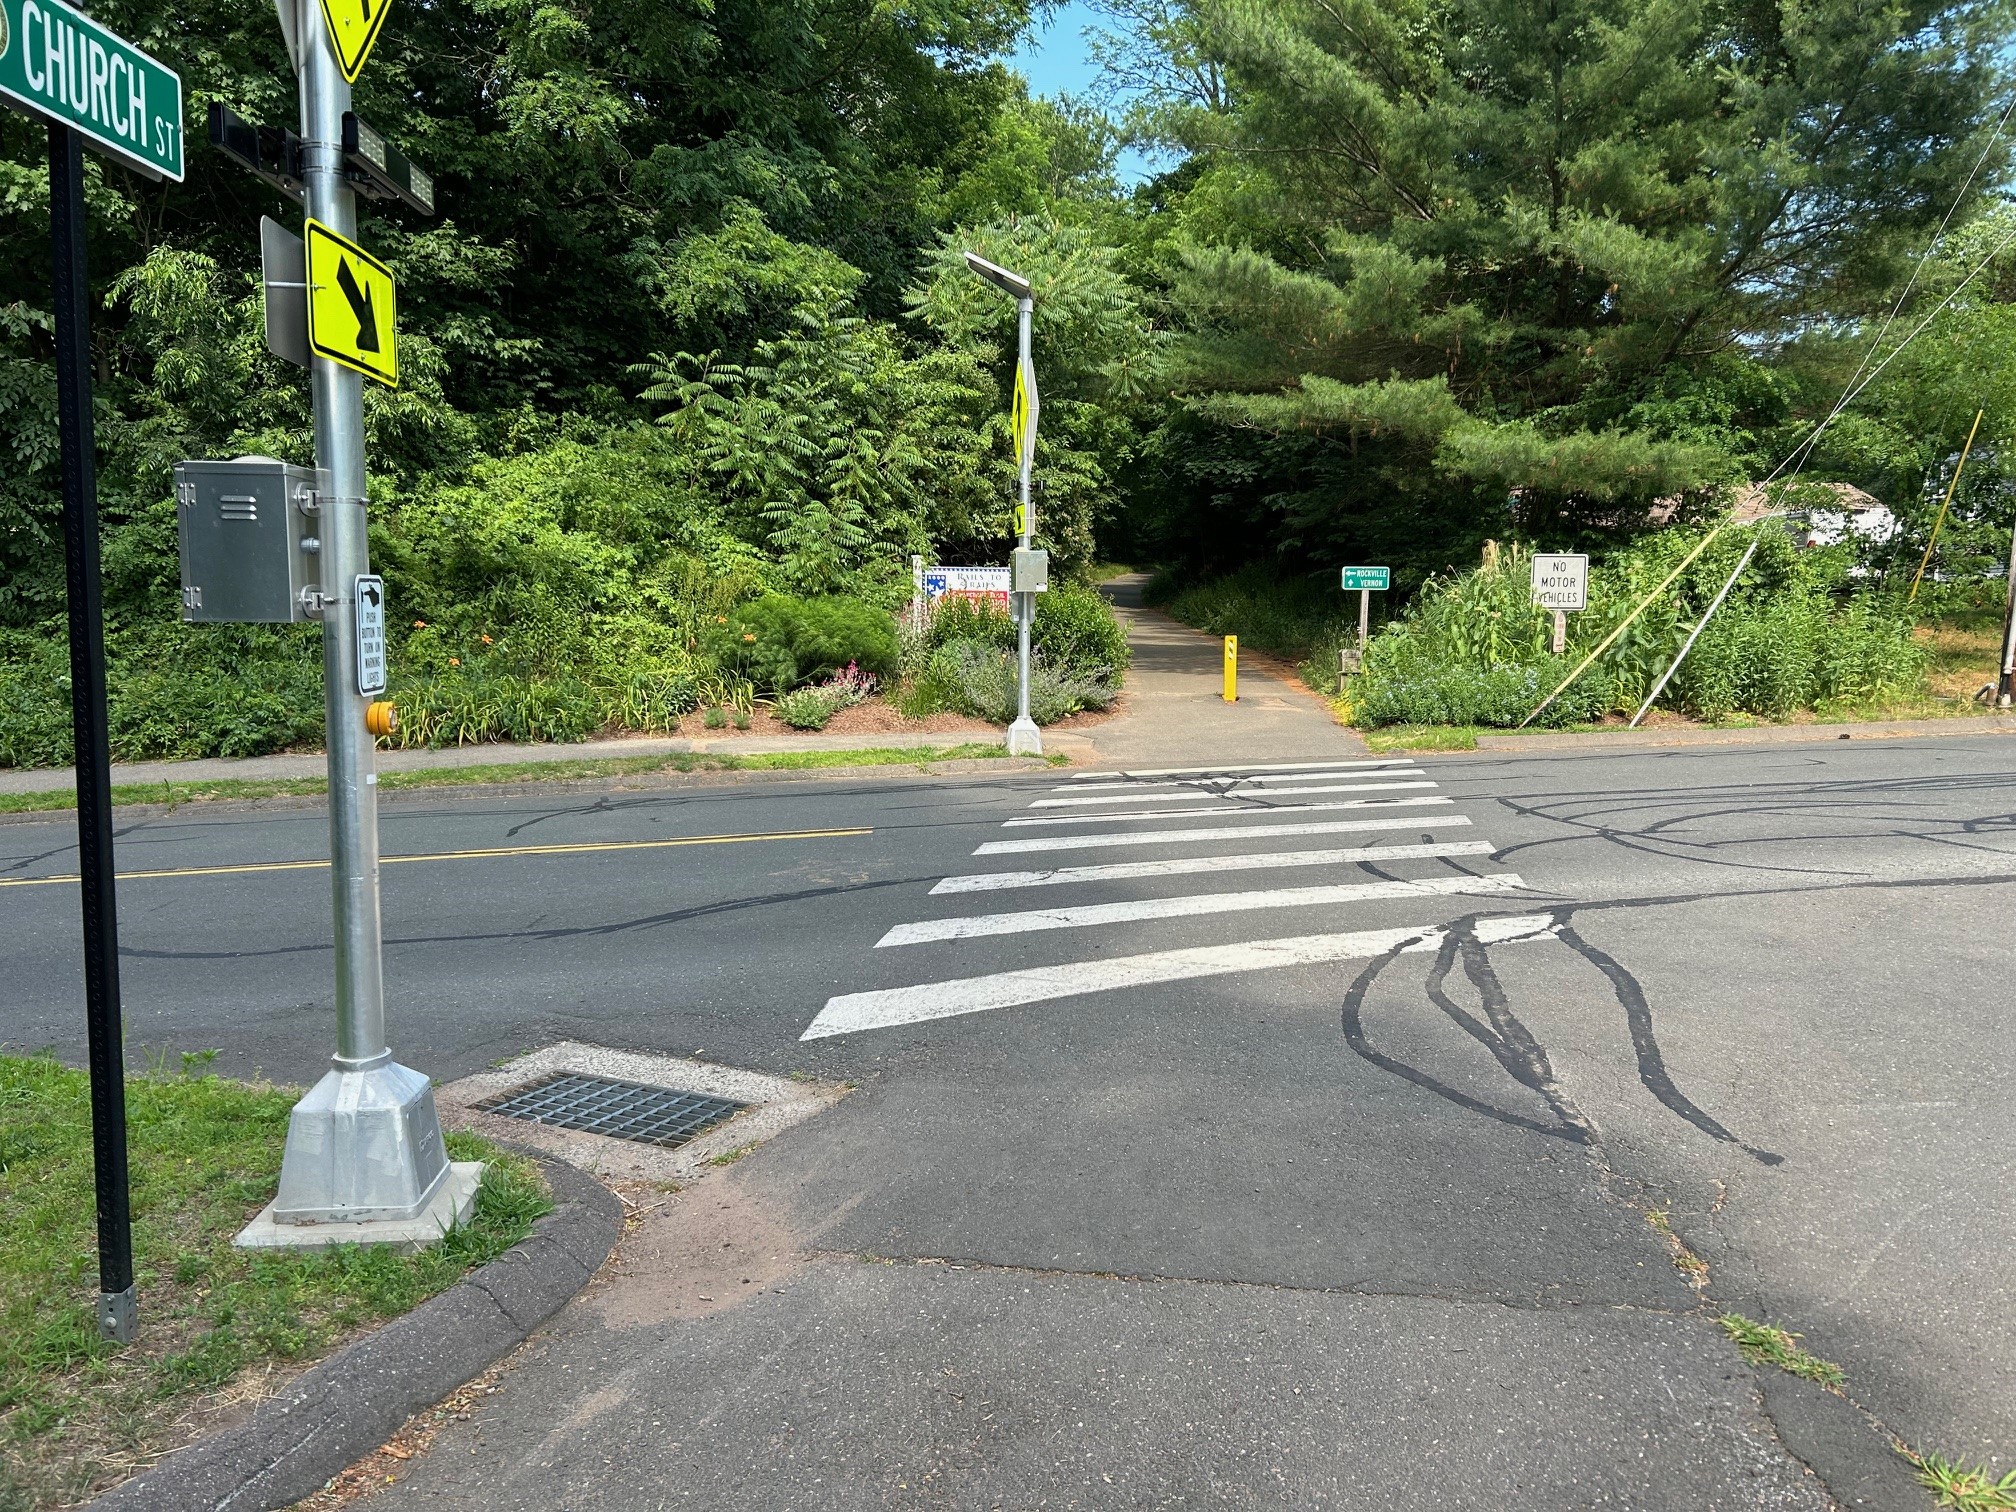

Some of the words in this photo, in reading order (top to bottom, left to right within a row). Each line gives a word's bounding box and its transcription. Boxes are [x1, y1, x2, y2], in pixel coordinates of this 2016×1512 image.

[22, 0, 148, 148] CHURCH
[155, 115, 174, 162] ST
[1552, 562, 1566, 572] NO
[1356, 570, 1387, 578] ROCKVILLE
[1541, 576, 1576, 588] MOTOR
[1538, 592, 1578, 602] VEHICLES
[366, 612, 376, 622] PUSH
[362, 628, 374, 638] BUTTON
[376, 626, 381, 638] TO
[364, 642, 373, 654] TURN
[375, 642, 380, 652] ON
[365, 656, 380, 668] WARNING
[367, 672, 379, 684] LIGHTS
